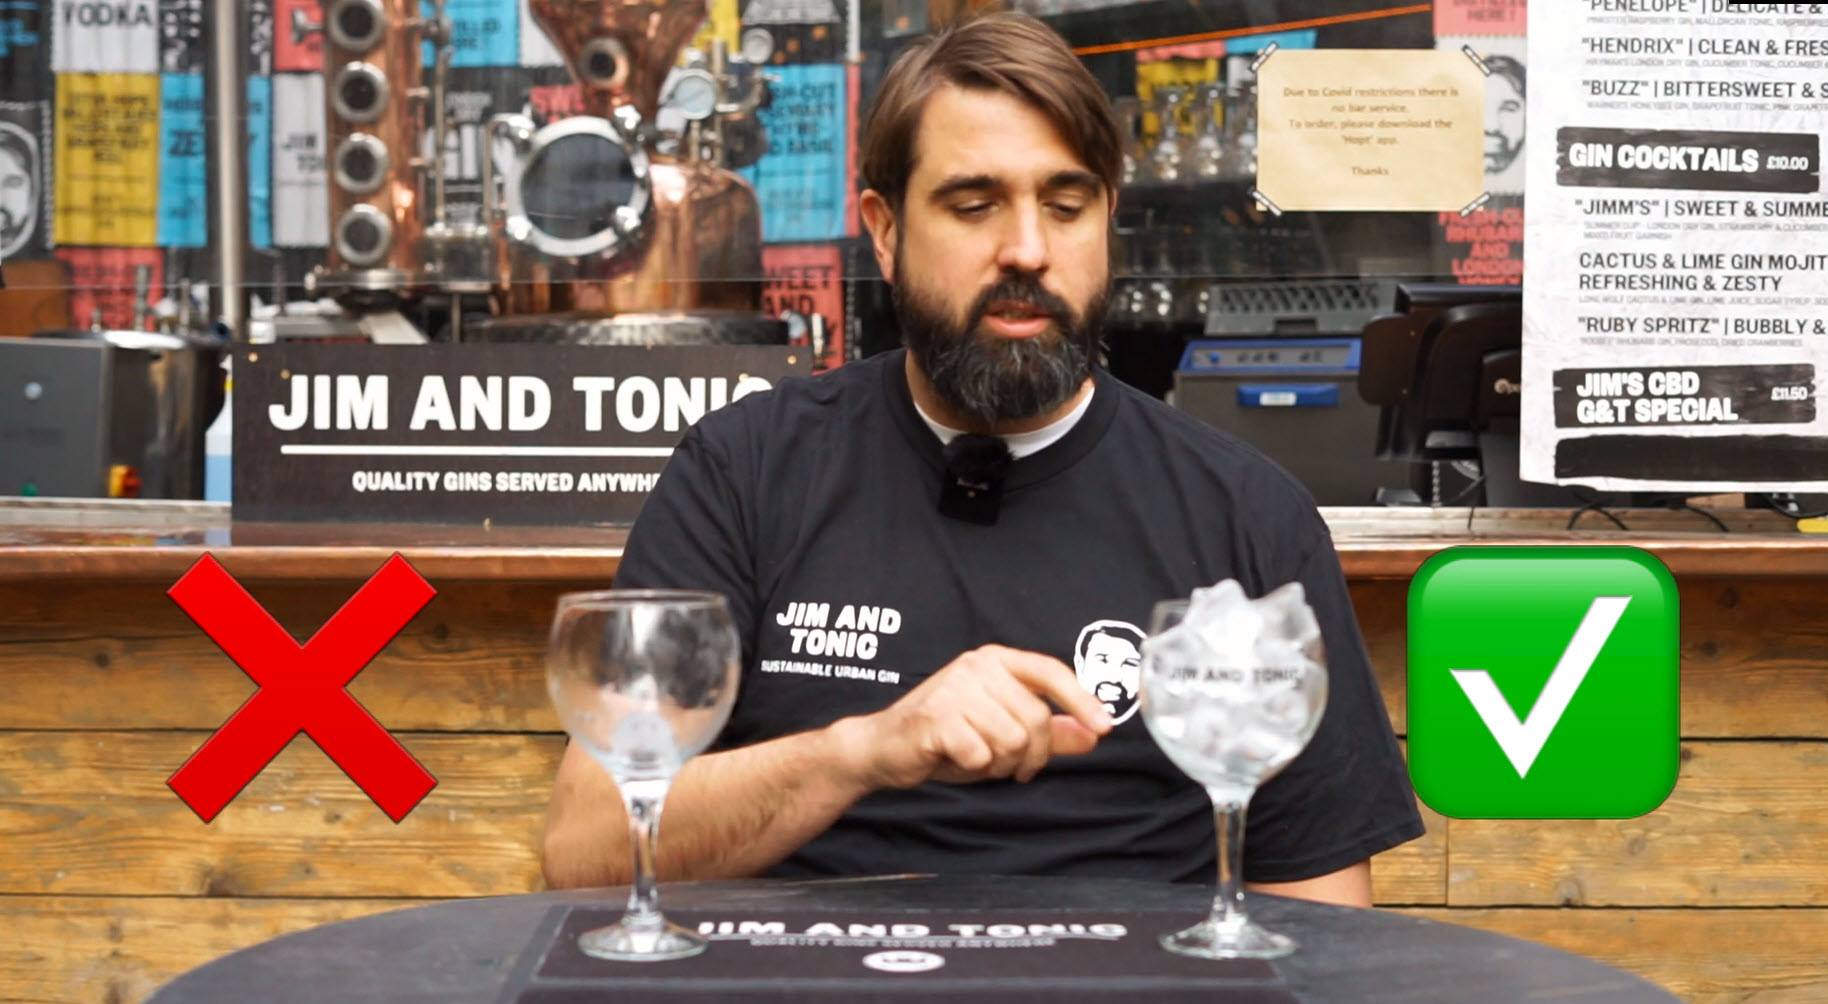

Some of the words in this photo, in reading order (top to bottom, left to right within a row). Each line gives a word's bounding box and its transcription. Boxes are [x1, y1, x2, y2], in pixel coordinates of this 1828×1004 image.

[1712, 0, 1804, 14] DELICATE
[1582, 37, 1683, 54] "HENDRIX"
[1698, 38, 1761, 55] CLEAN
[1766, 39, 1779, 55] &
[1785, 40, 1828, 56] FRES
[1284, 88, 1304, 97] Due
[1308, 88, 1319, 97] to
[1322, 87, 1352, 97] Covid
[1355, 87, 1415, 97] restrictions
[1418, 87, 1447, 97] there
[1450, 87, 1458, 96] is
[1582, 80, 1649, 96] "BUZZ"
[1664, 81, 1796, 98] BITTERSWEET
[1802, 82, 1815, 98] &
[1349, 103, 1365, 112] bar
[1369, 103, 1409, 112] service.
[1289, 120, 1301, 128] To
[1305, 119, 1337, 130] order,
[1340, 119, 1374, 130] please
[1377, 119, 1431, 128] download
[1434, 119, 1453, 128] the
[1568, 142, 1613, 168] GIN
[1617, 144, 1760, 173] COCKTAILS
[1766, 155, 1809, 171] £10.00
[1352, 166, 1389, 176] Thanks
[1575, 199, 1660, 216] "JIMM'S"
[1674, 200, 1739, 217] SWEET
[1744, 201, 1758, 217] &
[1763, 201, 1828, 218] SUMME
[1579, 252, 1657, 269] CACTUS
[1662, 253, 1676, 269] &
[1681, 253, 1726, 270] LIME
[1731, 254, 1763, 270] GIN
[1768, 254, 1828, 271] MOJIT
[1579, 274, 1698, 291] REFRESHING
[1703, 275, 1717, 291] &
[1722, 275, 1783, 292] ZESTY
[1578, 317, 1637, 333] "RUBY
[1643, 317, 1720, 334] SPRITZ"
[1734, 318, 1808, 335] BUBBLY
[1813, 319, 1826, 336] &
[1576, 372, 1645, 397] JIM'S
[1648, 371, 1700, 396] CBD
[1770, 386, 1808, 401] £11.50
[268, 374, 389, 431] JIM
[409, 375, 552, 431] AND
[1576, 399, 1632, 424] G&T
[1634, 397, 1739, 423] SPECIAL
[352, 470, 440, 493] QUALITY
[443, 471, 492, 493] GINS
[495, 471, 573, 493] SERVED
[776, 602, 831, 628] JIM
[834, 604, 902, 635] AND
[789, 628, 879, 661] TONIC
[760, 659, 833, 677] SUSTAINABLE
[834, 664, 876, 682] URBAN
[877, 669, 901, 685] GIN
[804, 922, 930, 938] AND
